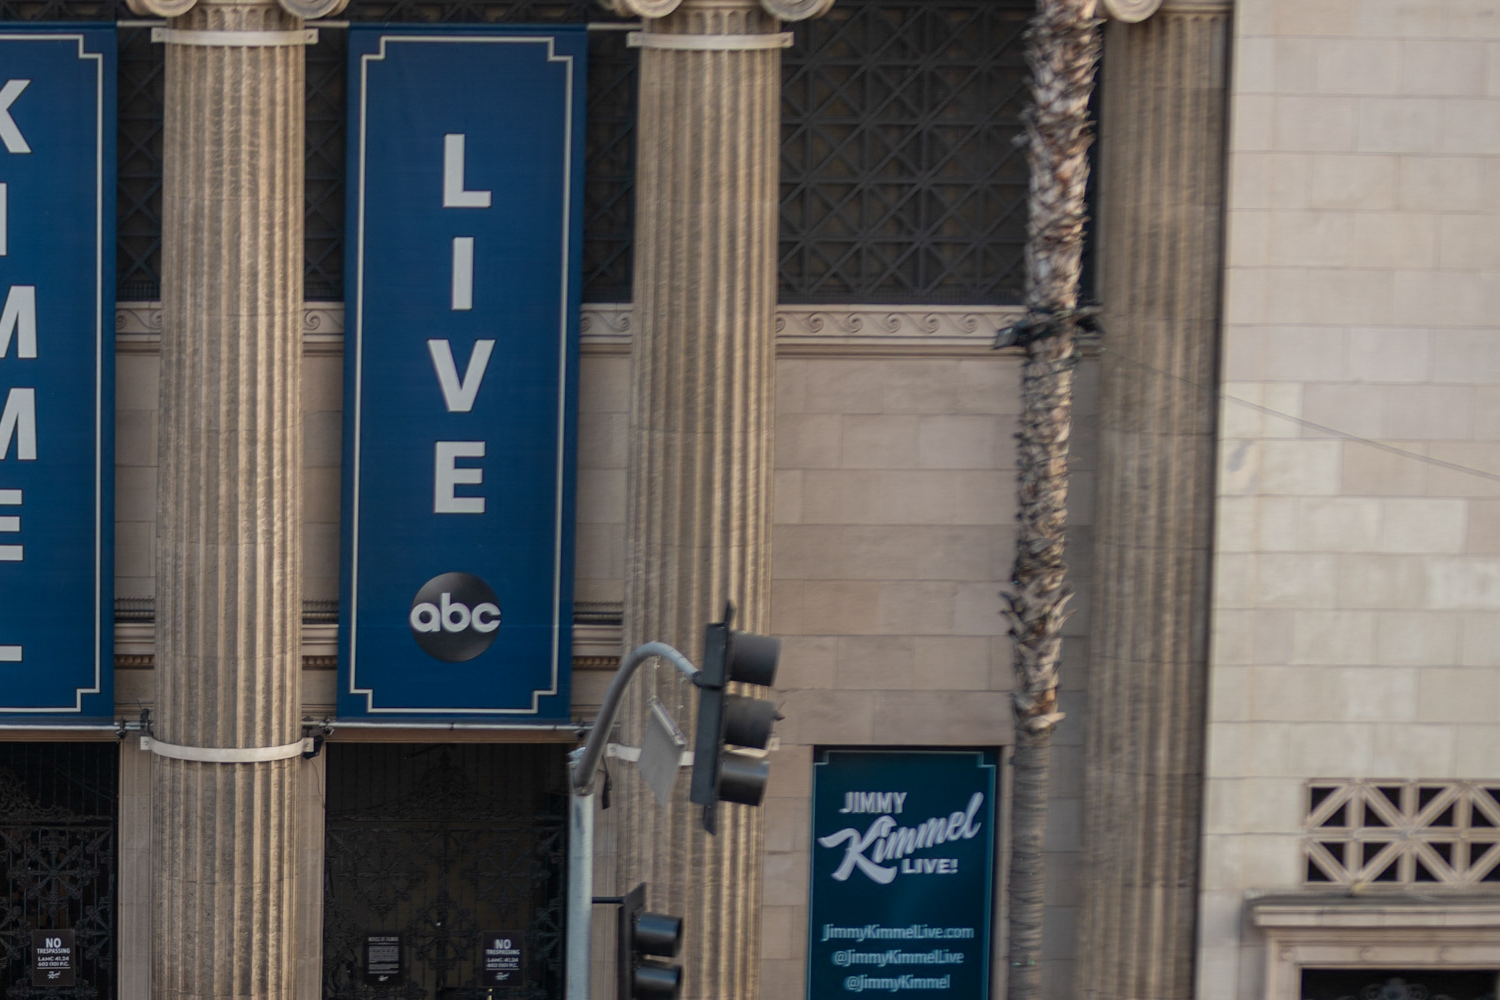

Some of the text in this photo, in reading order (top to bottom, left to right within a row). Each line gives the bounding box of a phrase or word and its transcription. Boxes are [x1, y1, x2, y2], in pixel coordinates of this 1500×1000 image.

[427, 133, 496, 514] LIVE
[409, 592, 501, 634] abc
[839, 792, 907, 814] JIMMY
[817, 792, 984, 884] Kimmel
[902, 858, 958, 874] LIVE!
[821, 924, 974, 942] JimmyKimmelLive.com
[45, 937, 62, 949] NO
[494, 938, 511, 949] NO
[831, 949, 964, 967] @JimmyKimmelLive
[844, 974, 950, 992] @JimmyKimmel
